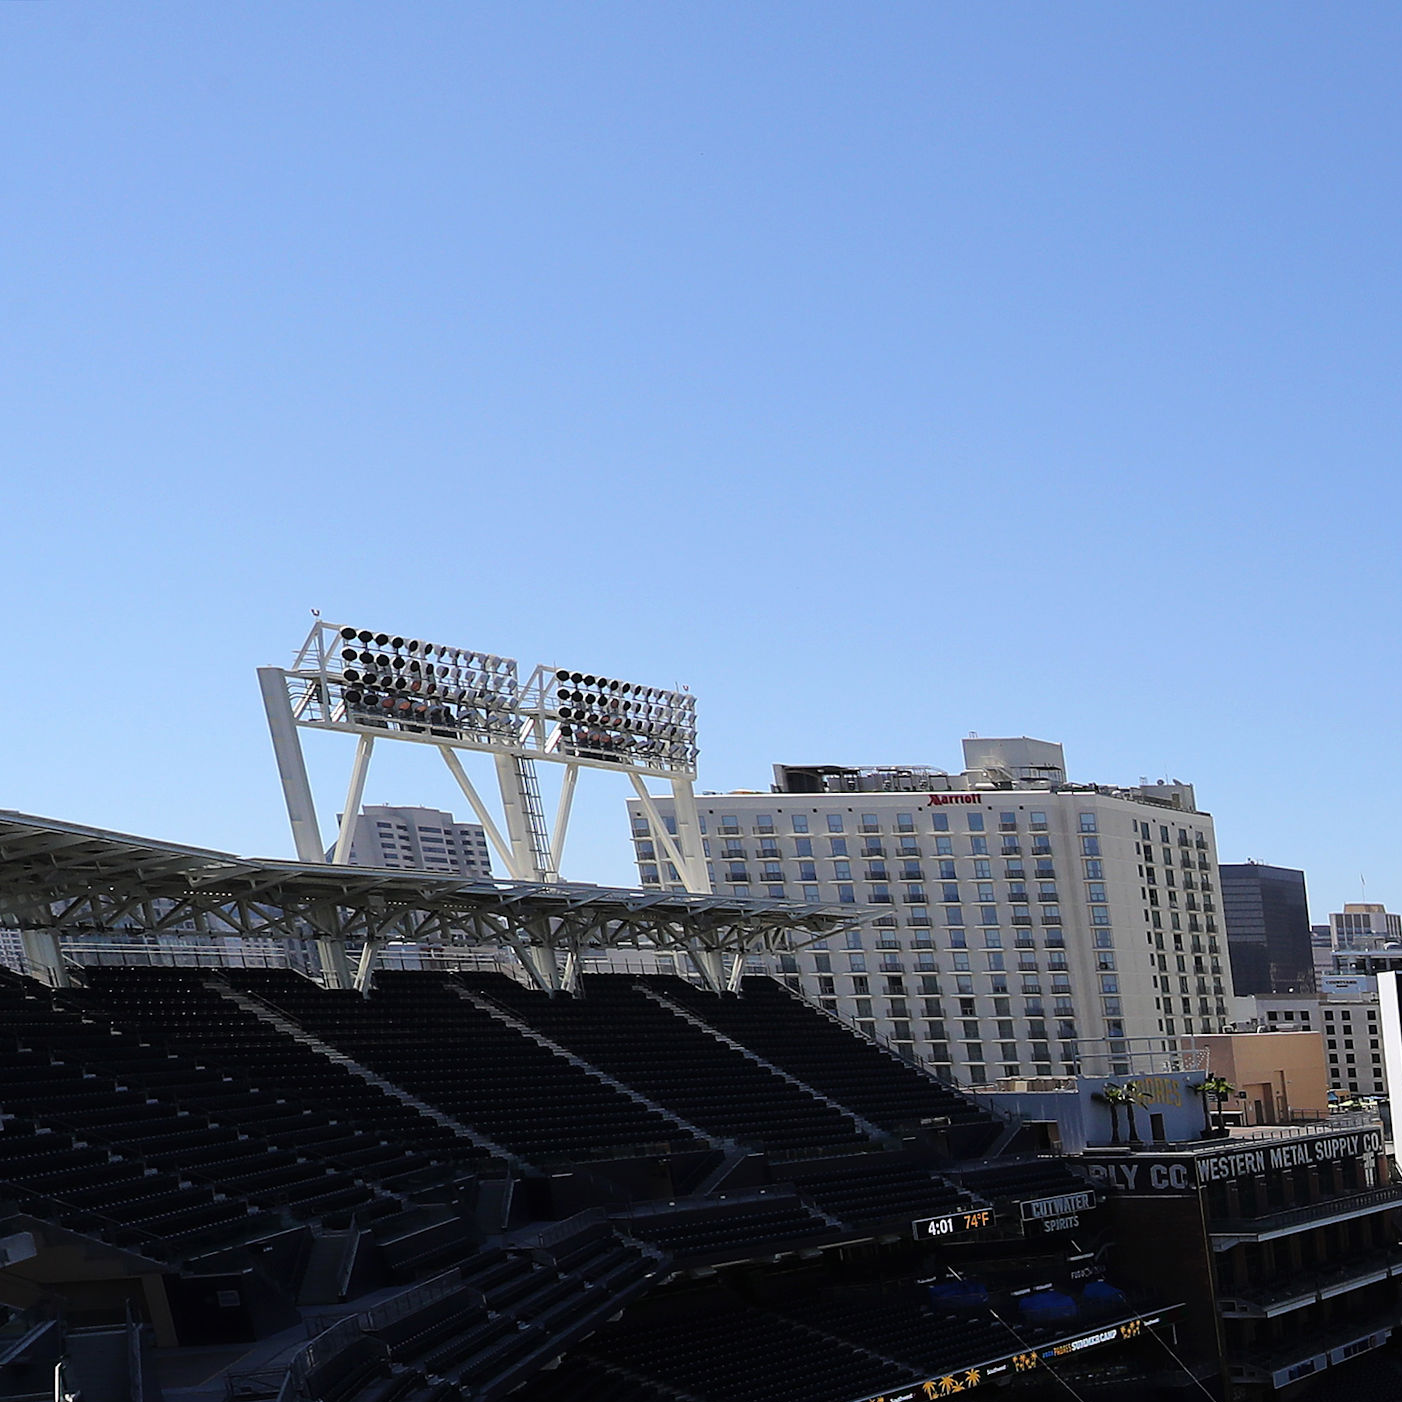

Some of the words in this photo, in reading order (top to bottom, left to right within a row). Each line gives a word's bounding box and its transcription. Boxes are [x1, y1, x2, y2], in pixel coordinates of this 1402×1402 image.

[928, 794, 982, 806] Marriott
[1197, 1152, 1266, 1183] WESTERN
[1271, 1143, 1311, 1173] METAL
[1315, 1135, 1360, 1165] SUPPLY
[1363, 1131, 1383, 1157] CO.
[1150, 1164, 1192, 1191] CO.
[1031, 1194, 1089, 1217] CUTWATER
[927, 1217, 954, 1236] 4:01
[963, 1211, 990, 1230] 74°F
[1043, 1216, 1080, 1233] SPIRITS
[1071, 1333, 1101, 1352] SUMMER
[1099, 1329, 1117, 1343] CAMP
